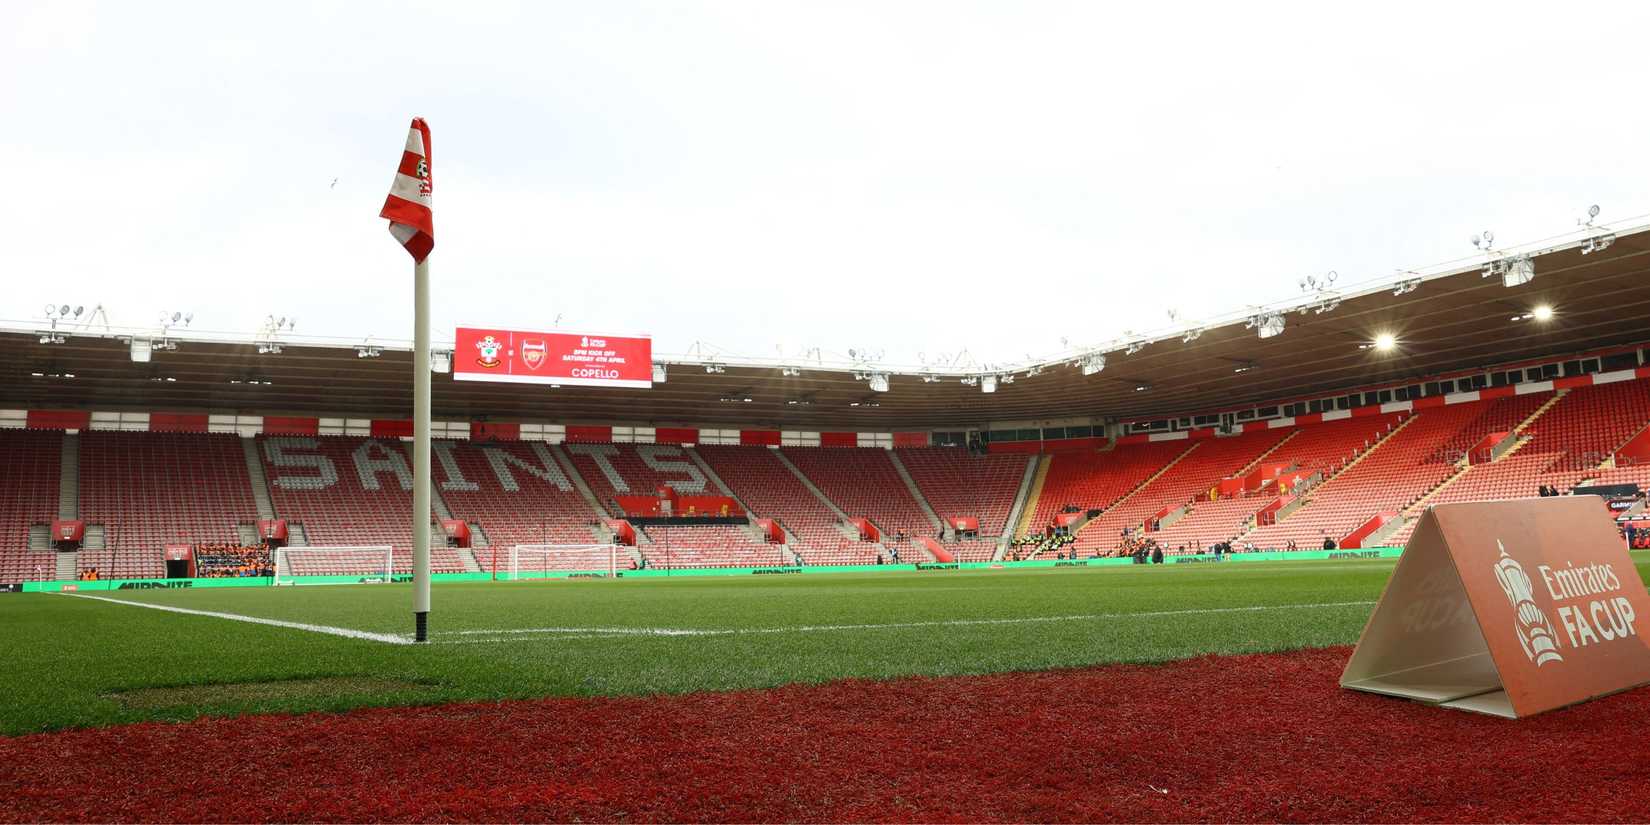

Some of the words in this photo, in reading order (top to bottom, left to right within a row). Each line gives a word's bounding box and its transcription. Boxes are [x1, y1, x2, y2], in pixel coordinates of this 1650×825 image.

[571, 368, 619, 379] COPELLO
[263, 437, 708, 494] SAINTS
[1538, 561, 1621, 600] Emirates
[1558, 606, 1600, 648] FA
[1590, 597, 1636, 641] CUP
